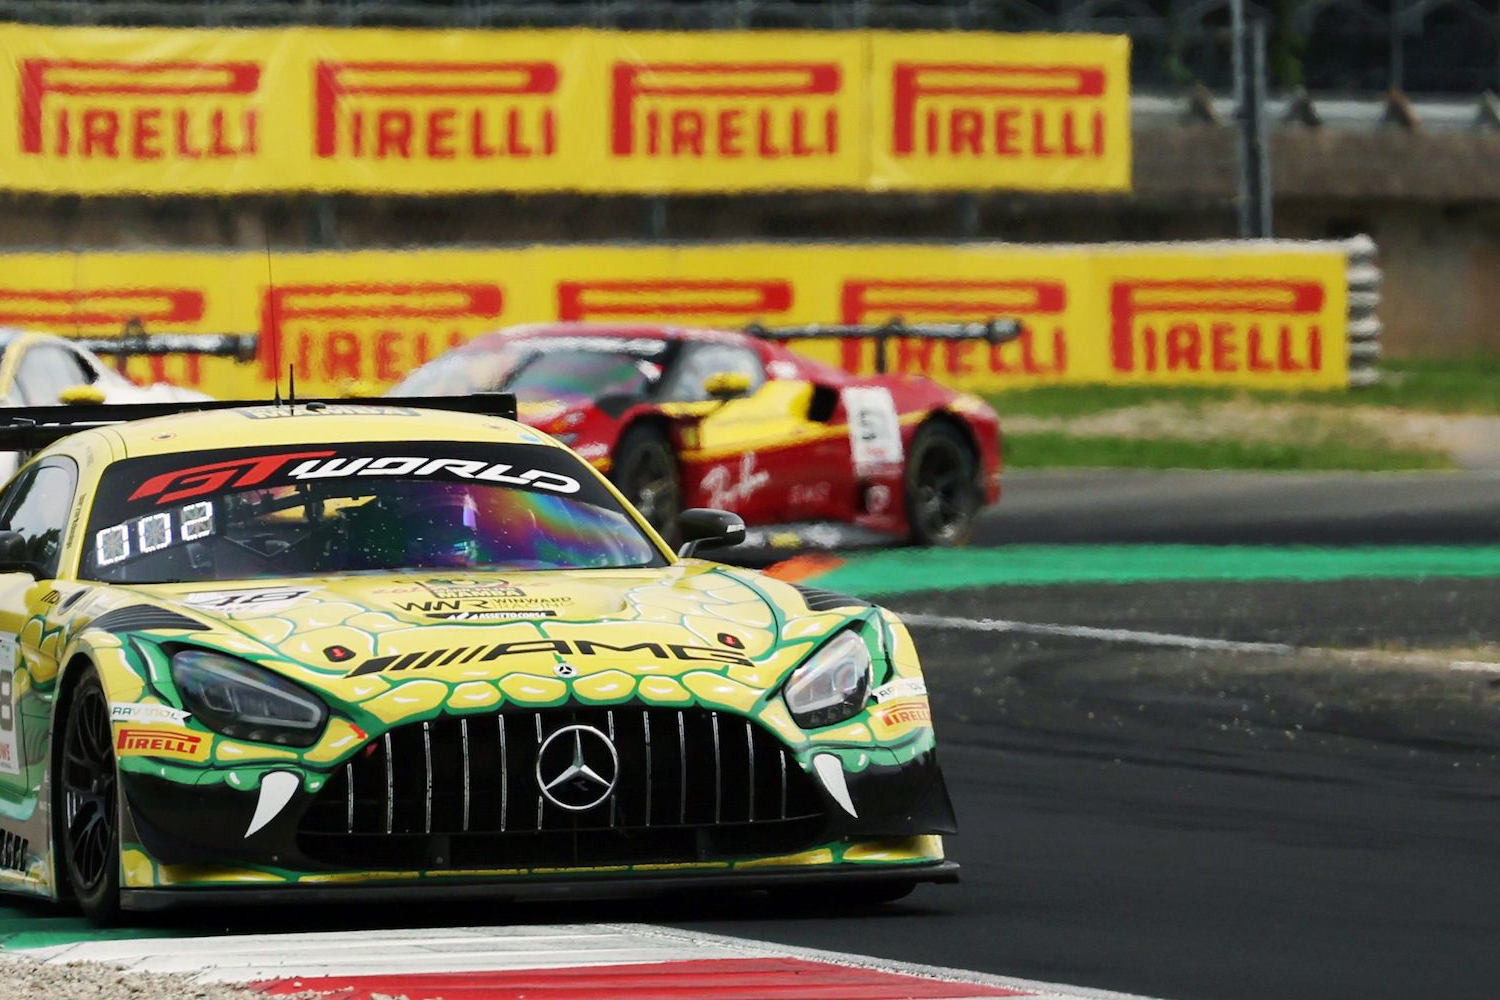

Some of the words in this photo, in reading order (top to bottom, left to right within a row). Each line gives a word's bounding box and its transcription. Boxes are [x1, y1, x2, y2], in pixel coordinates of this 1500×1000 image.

[18, 59, 261, 160] PIRELLI
[313, 61, 560, 160] PIRELLI
[611, 62, 843, 159] PIRELLI
[892, 63, 1106, 158] PIRELLI
[1109, 280, 1326, 373] PIRELLI
[127, 450, 336, 505] GT
[287, 456, 581, 494] WORLD
[97, 500, 214, 567] 002
[479, 638, 757, 668] AMG
[117, 728, 202, 754] PIRELLI
